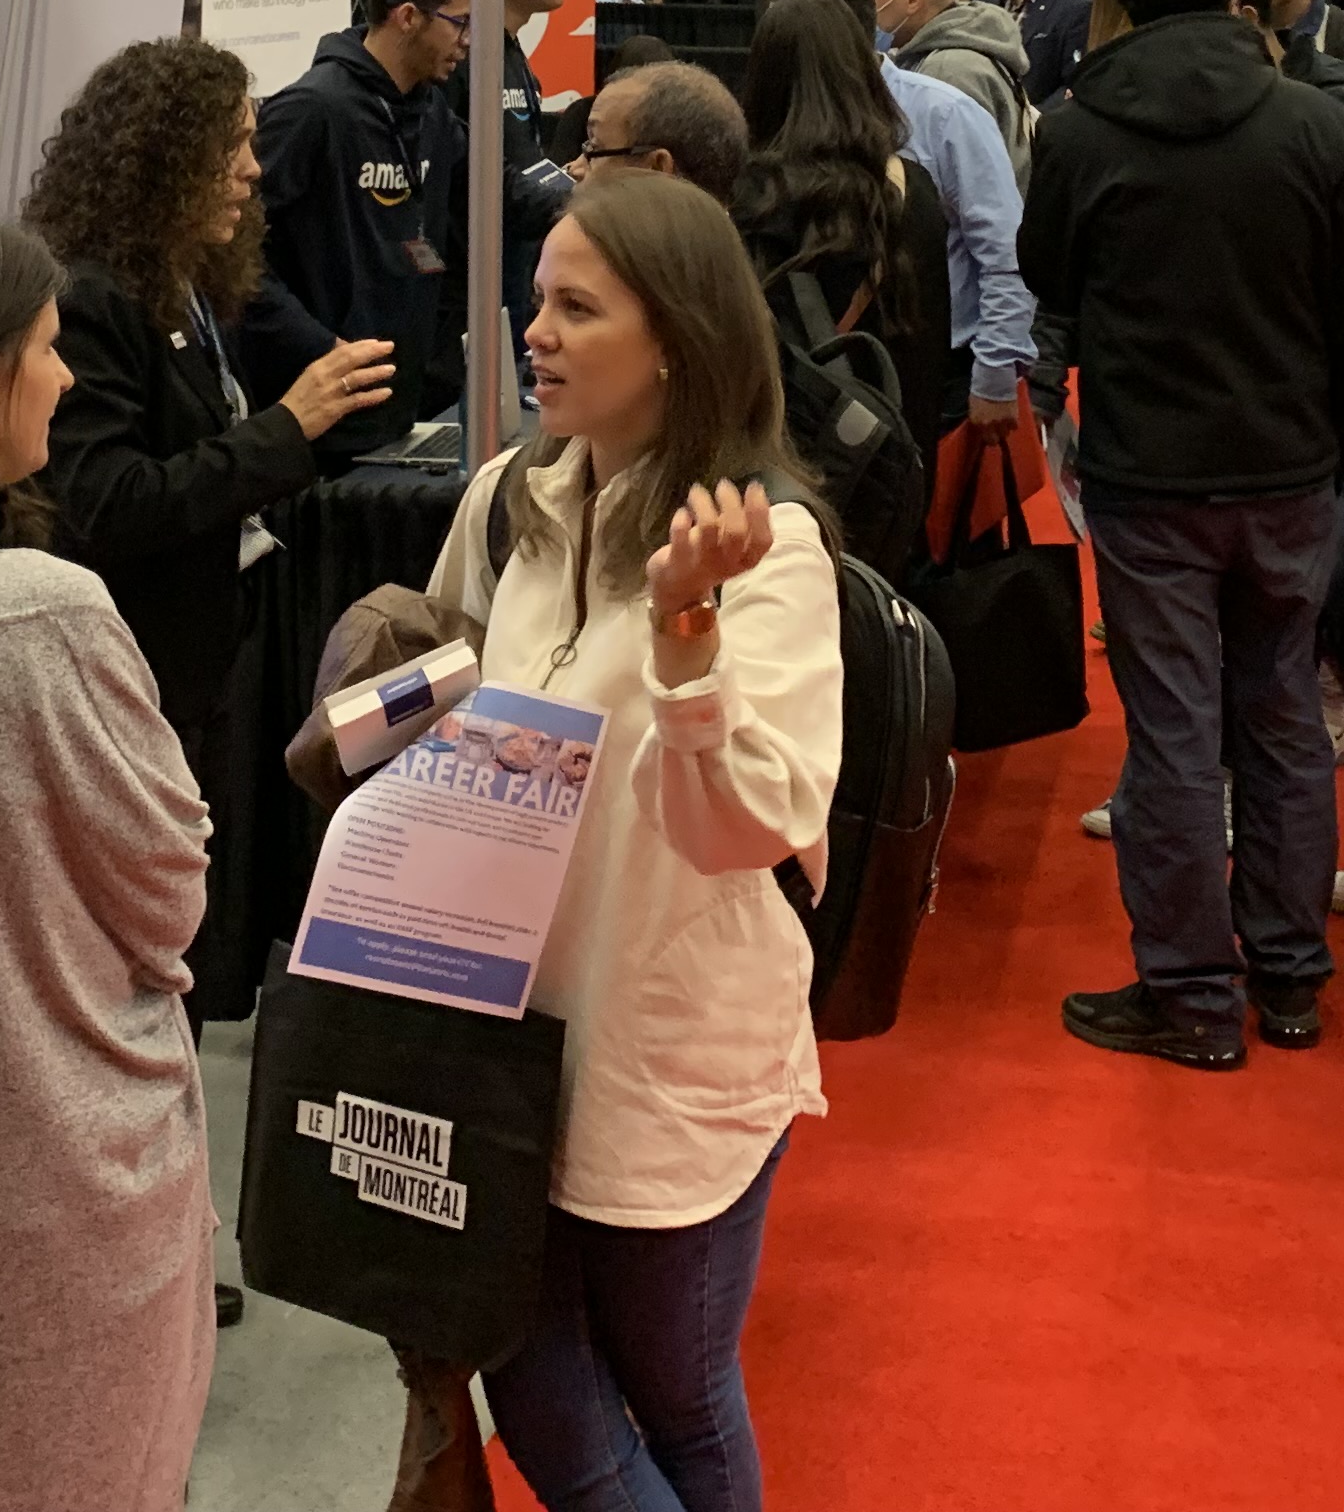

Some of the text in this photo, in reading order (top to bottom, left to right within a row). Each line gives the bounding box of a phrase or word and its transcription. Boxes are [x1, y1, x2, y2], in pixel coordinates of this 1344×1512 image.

[504, 774, 579, 818] FAIR
[308, 1100, 443, 1167] LE JOURNAL
[339, 1152, 460, 1221] DE MONTRÉAL
